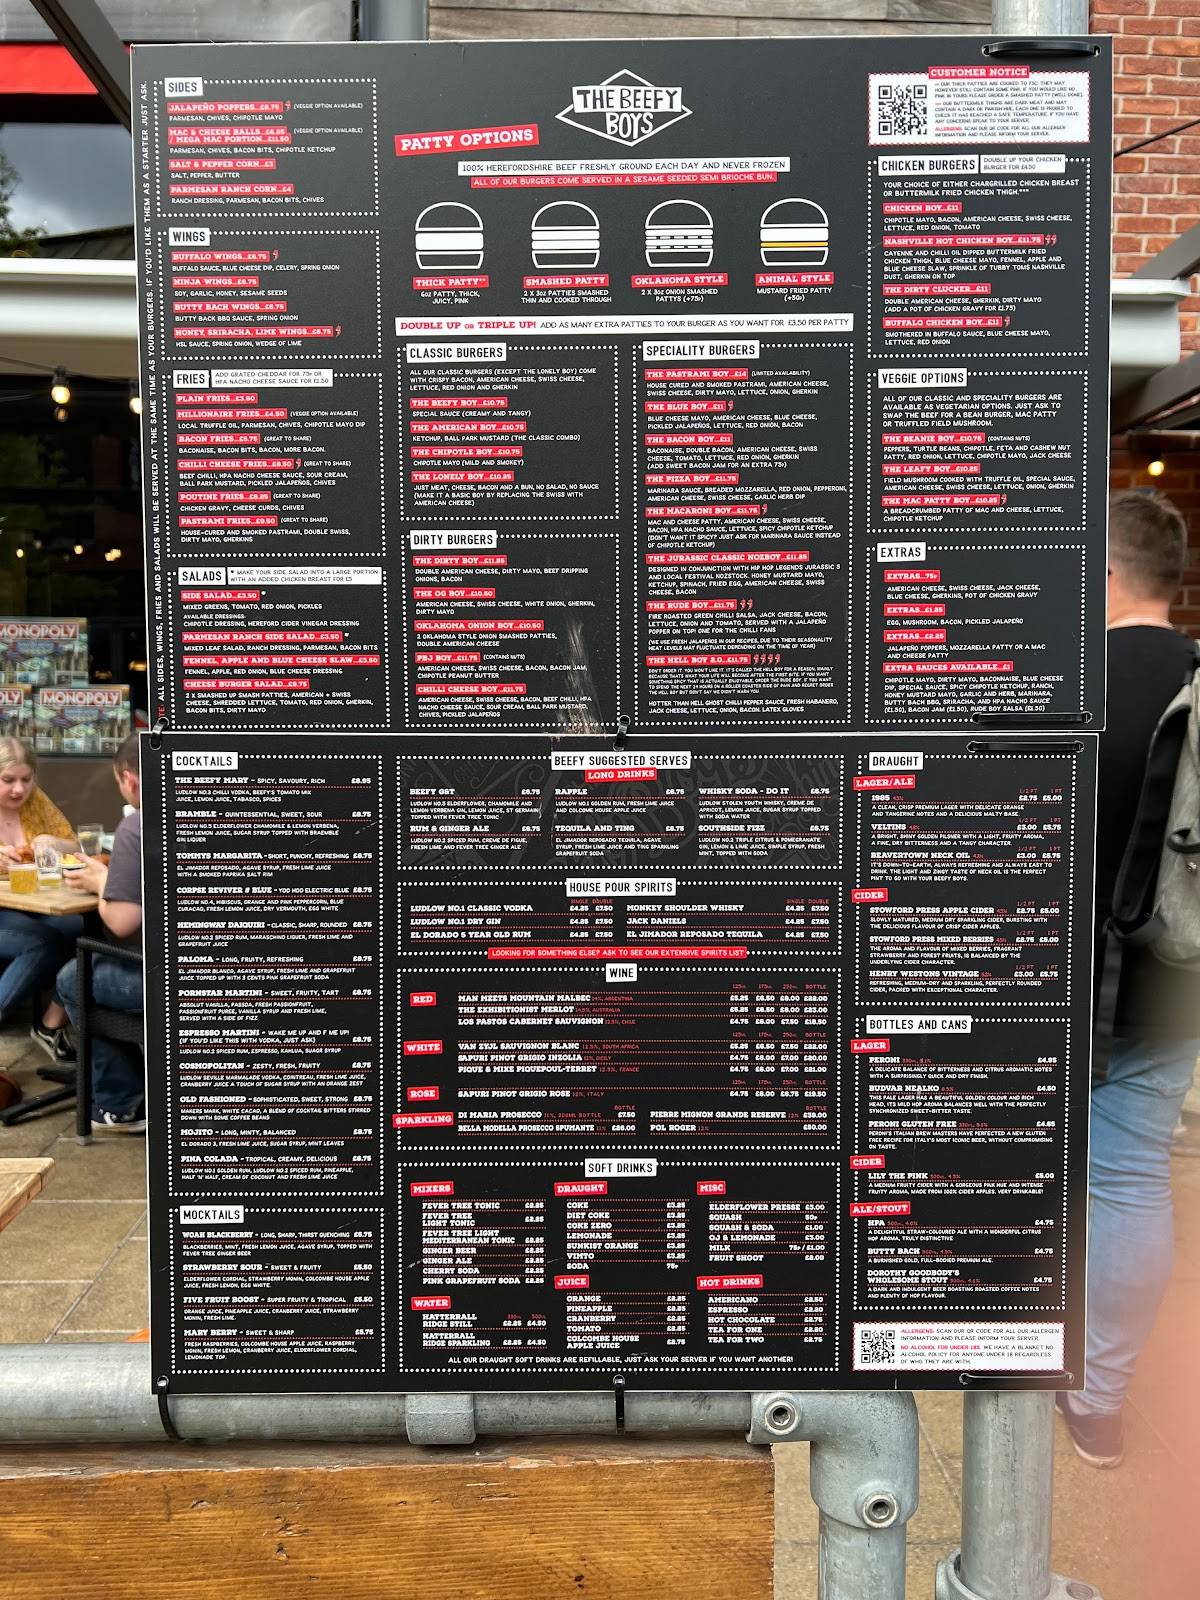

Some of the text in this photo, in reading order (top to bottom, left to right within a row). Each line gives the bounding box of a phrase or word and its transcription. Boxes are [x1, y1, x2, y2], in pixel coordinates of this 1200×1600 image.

[168, 82, 196, 92] SIDES
[576, 89, 678, 110] THE BEEFY
[606, 112, 654, 139] BOYS
[401, 128, 532, 150] PATTY OPTIONS
[882, 159, 974, 170] CHICKEN BURGERS
[520, 176, 554, 184] BURGERS
[143, 184, 149, 195] AS
[172, 231, 204, 241] WINGS
[416, 277, 445, 286] THICK
[410, 347, 502, 357] CLASSIC BURGERS
[646, 344, 754, 355] SPECIALITY BURGERS
[148, 360, 154, 371] AS
[177, 374, 204, 383] FRIES
[882, 372, 963, 383] VEGGIE OPTIONS
[151, 449, 157, 460] AT
[152, 501, 158, 511] BE
[414, 534, 492, 544] DIRTY BURGERS
[881, 547, 920, 556] EXTRAS
[182, 571, 221, 580] SALADS
[43, 691, 120, 705] MONOPOLY
[176, 756, 231, 765] COCKTAILS
[554, 755, 687, 768] BEEFY SUGGESTED SERVES
[872, 756, 918, 765] DRAUGHT
[856, 778, 912, 786] LAGER/ALE
[570, 882, 672, 891] HOUSE POUR SPIRITS
[609, 968, 632, 977] WINE
[870, 1019, 966, 1029] BOTTLES AND CANS
[395, 1115, 451, 1124] SPARKLING
[588, 1163, 652, 1172] SOFT DRINKS
[557, 1184, 603, 1192] DRAUGHT
[852, 1204, 907, 1212] ALE/STOUT
[183, 1210, 239, 1219] MOCKTAILS
